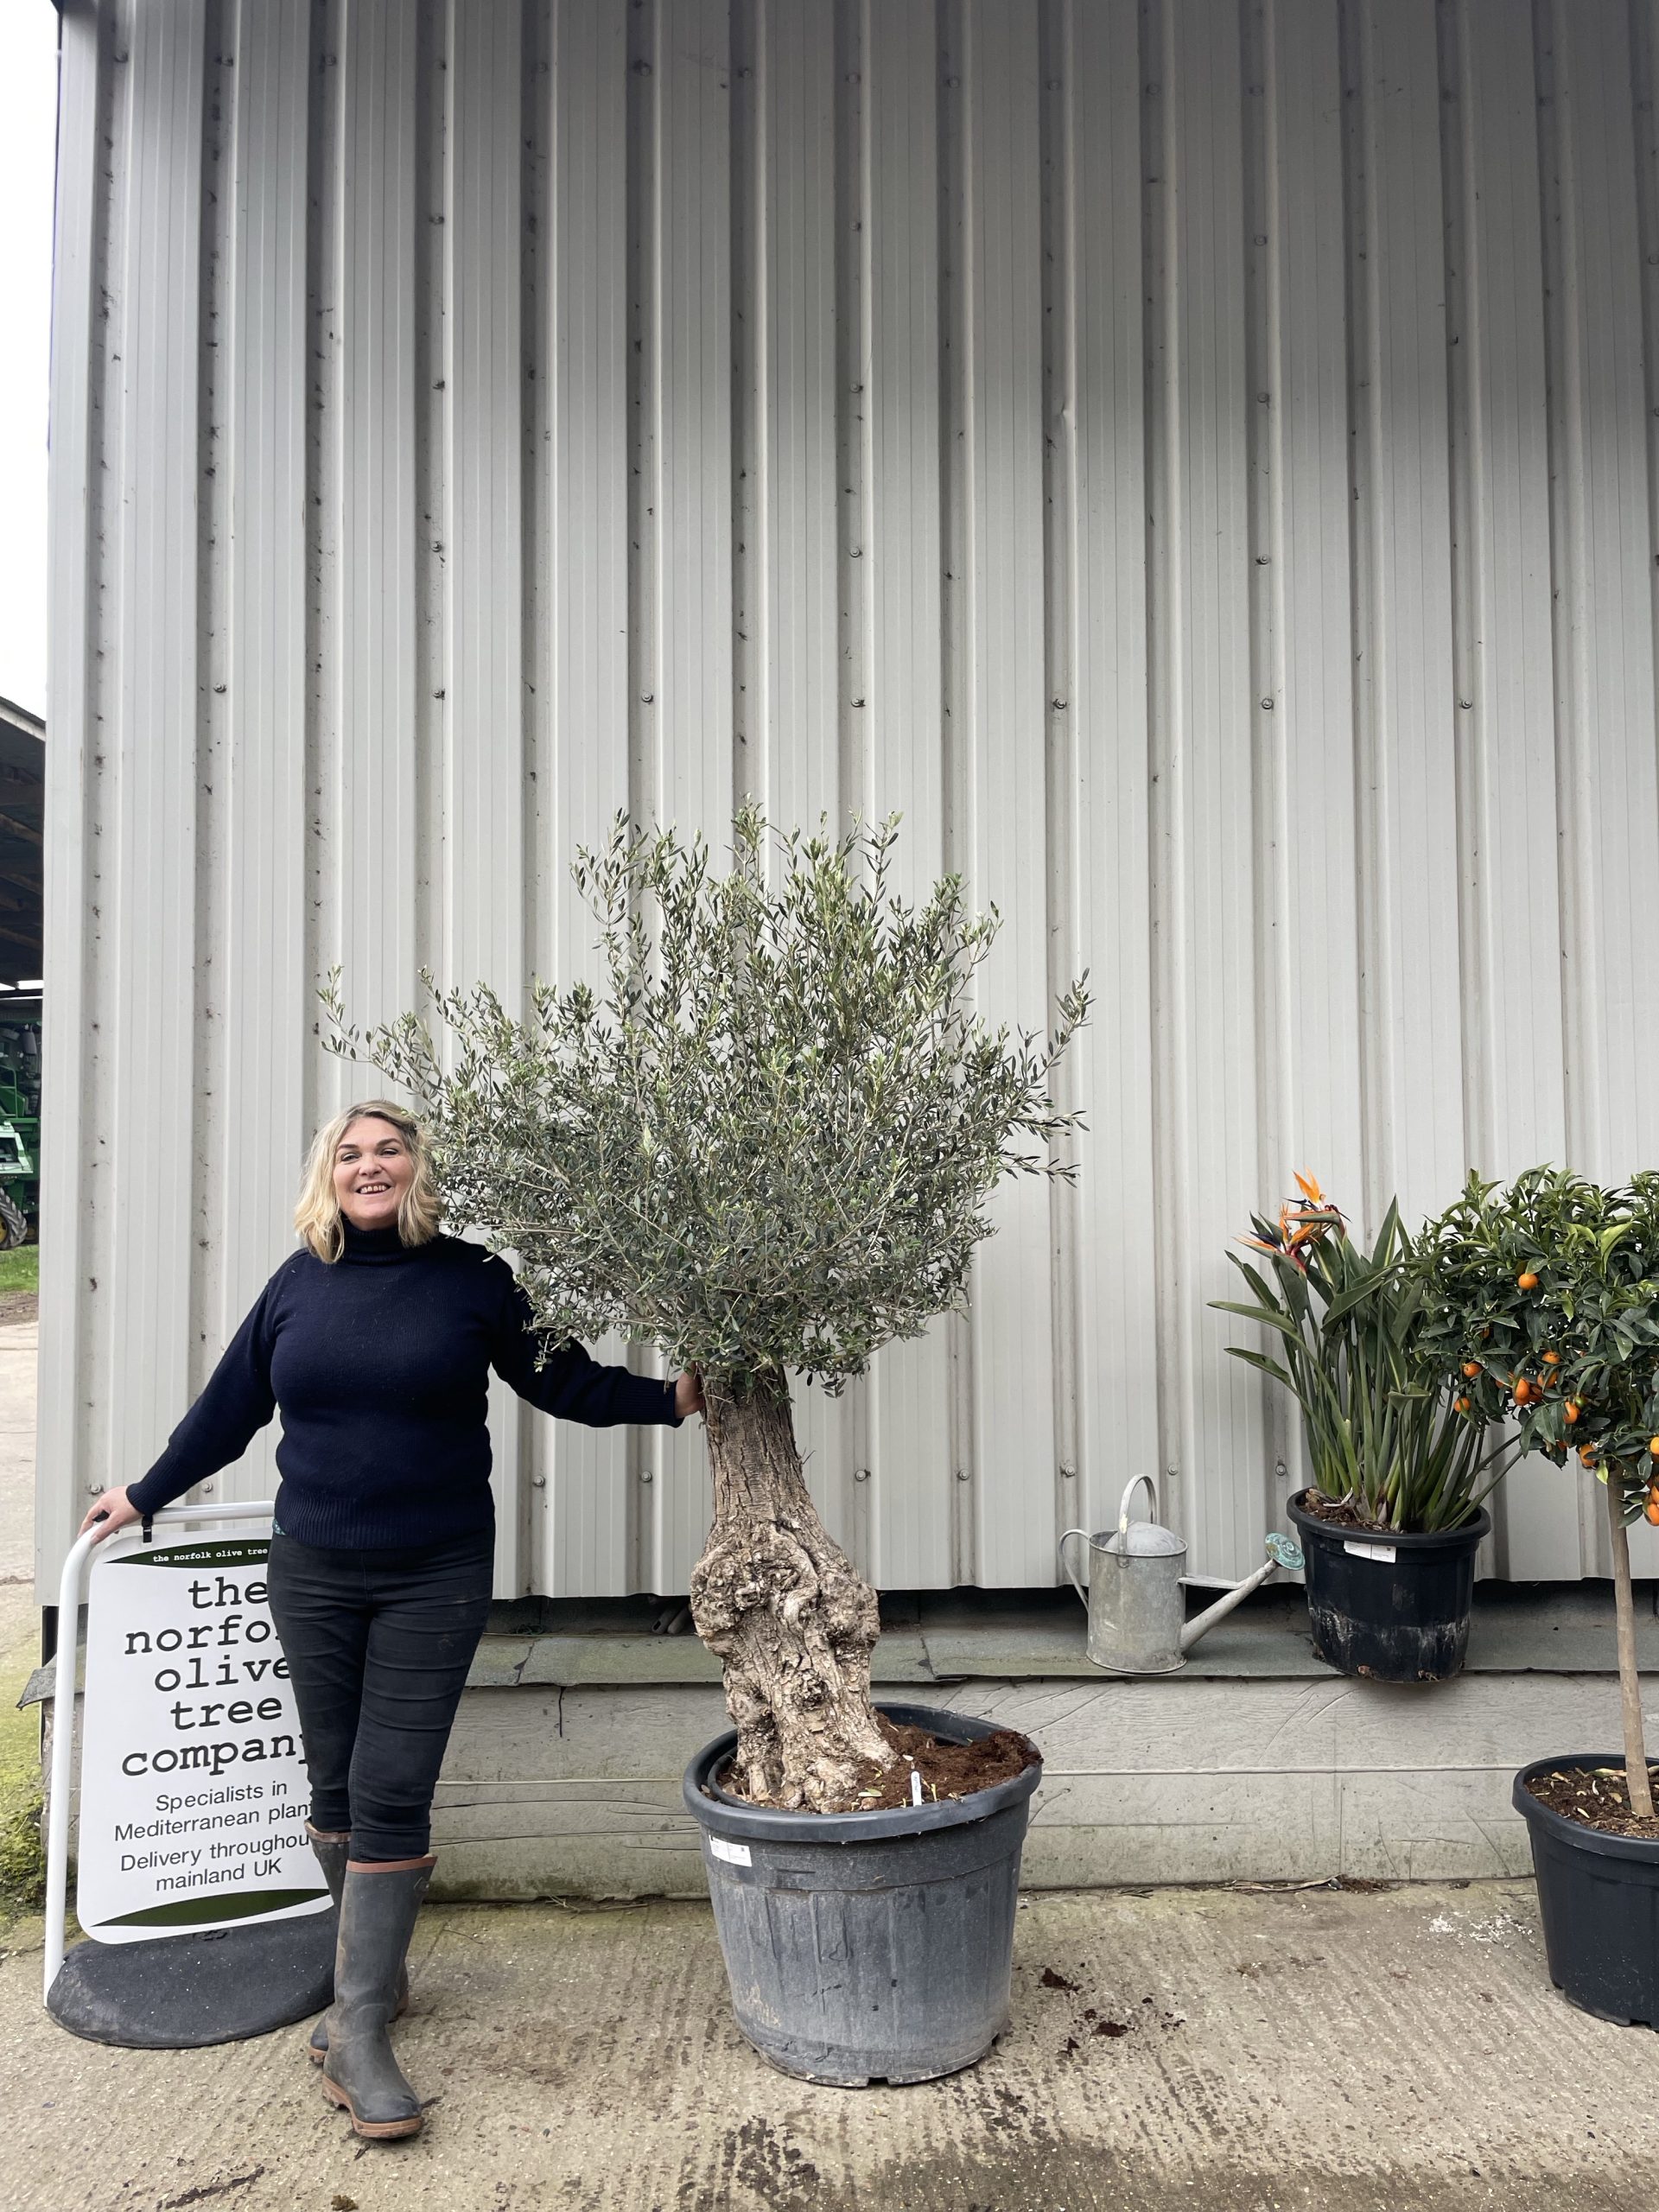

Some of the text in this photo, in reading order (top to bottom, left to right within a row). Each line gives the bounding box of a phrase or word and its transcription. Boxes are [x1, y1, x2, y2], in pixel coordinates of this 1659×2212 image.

[174, 1551, 212, 1561] norfolk
[216, 1549, 243, 1558] olive
[188, 1576, 268, 1609] the
[125, 1614, 281, 1655] norfo
[156, 1655, 289, 1692] olive
[171, 1696, 283, 1730] tree
[122, 1732, 307, 1777] compan
[156, 1780, 288, 1813] Specialists in
[115, 1802, 312, 1841] Mediterranean plan
[121, 1834, 309, 1872] Delivery throughou
[156, 1858, 282, 1891] mainland UK
